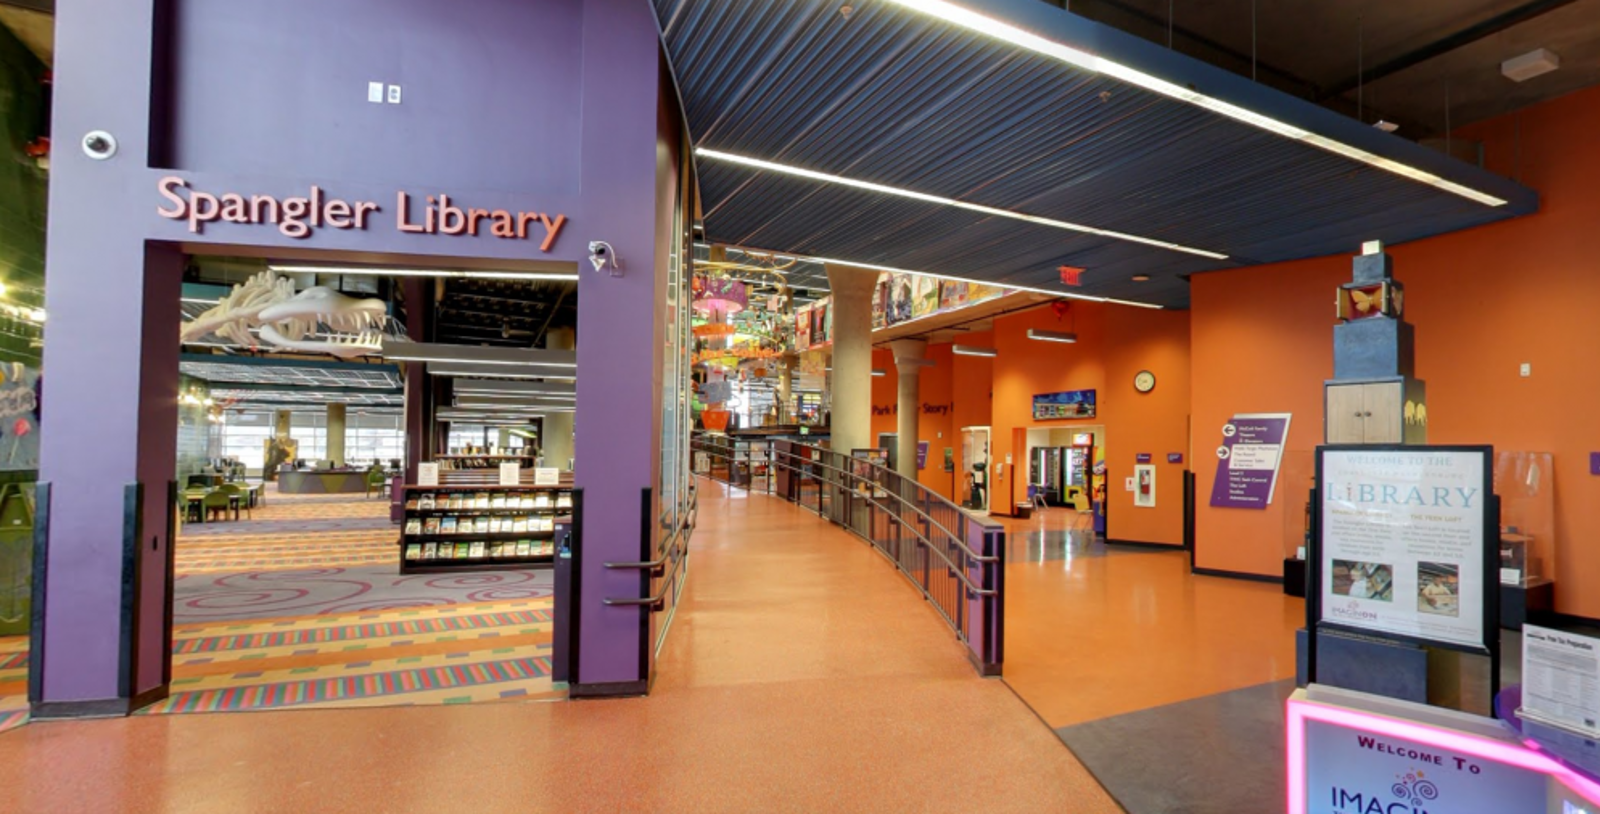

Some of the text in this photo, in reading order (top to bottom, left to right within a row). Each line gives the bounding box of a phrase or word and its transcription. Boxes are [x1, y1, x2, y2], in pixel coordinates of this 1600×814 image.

[156, 175, 568, 251] Spangler Library
[871, 405, 890, 416] Park
[922, 402, 948, 416] Story
[1347, 455, 1453, 467] WELCOME TO THE
